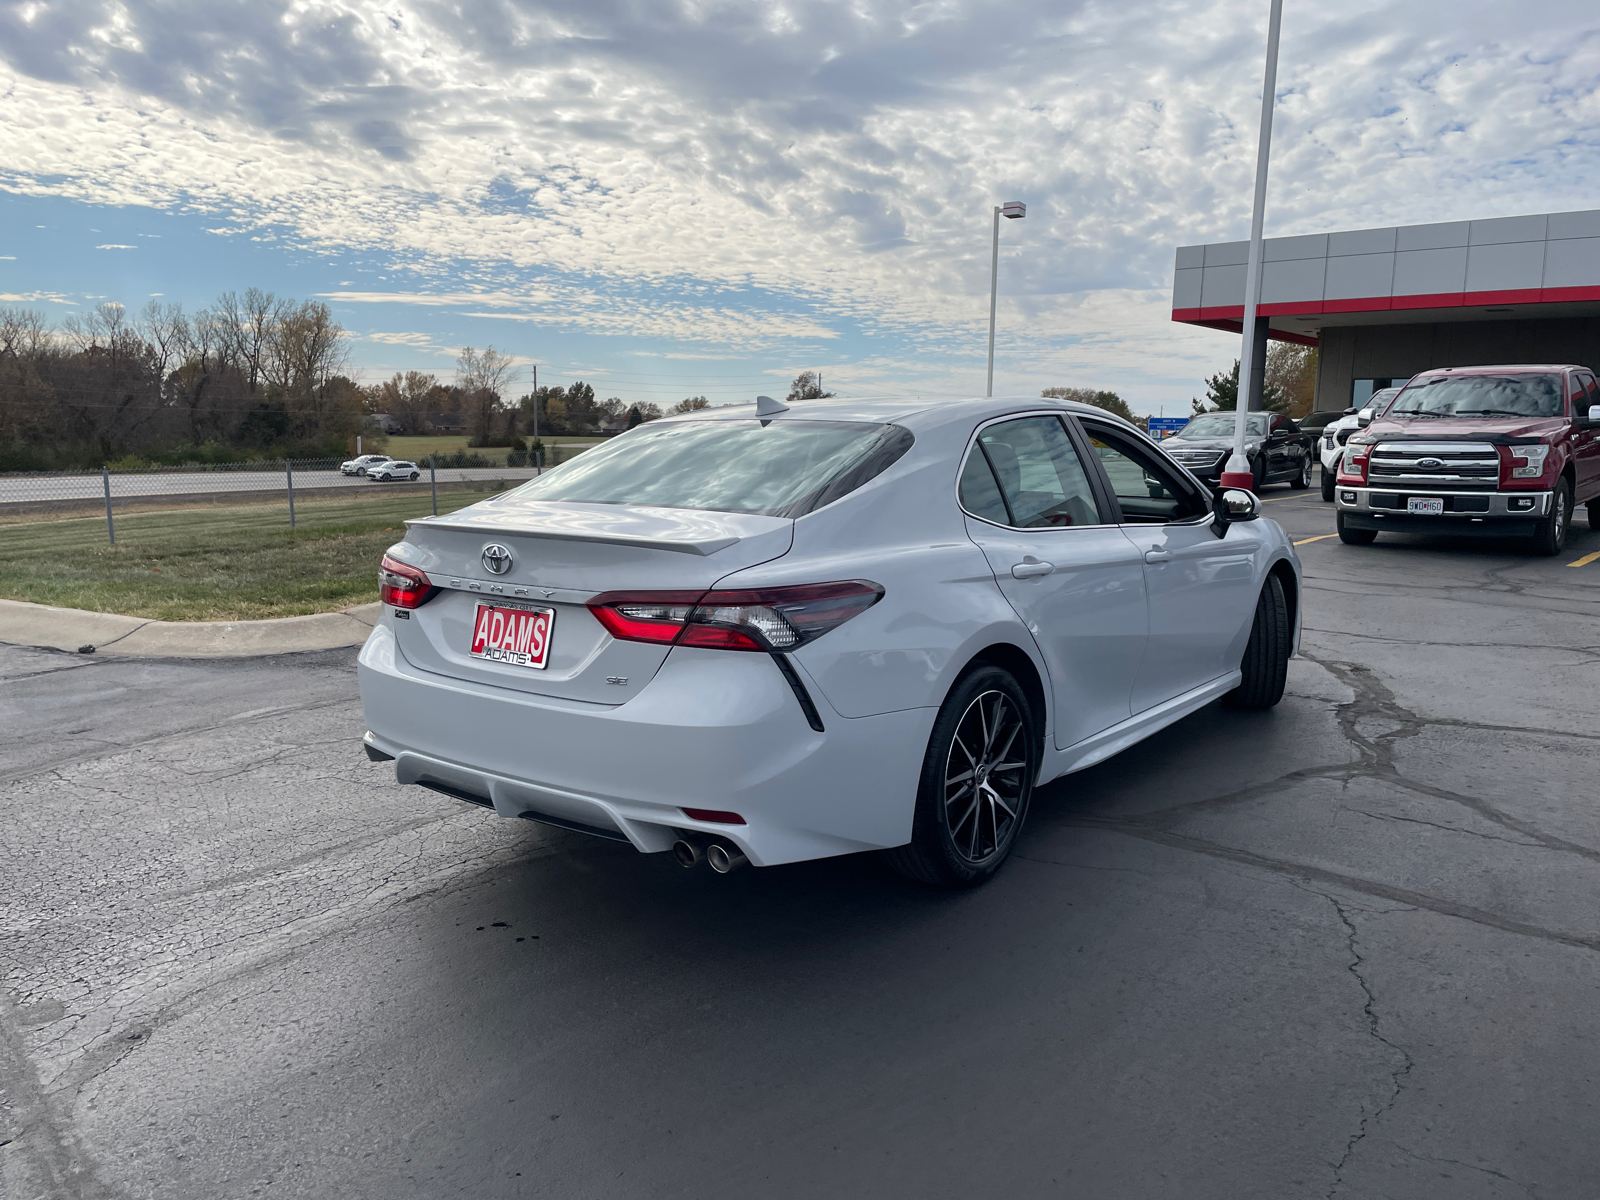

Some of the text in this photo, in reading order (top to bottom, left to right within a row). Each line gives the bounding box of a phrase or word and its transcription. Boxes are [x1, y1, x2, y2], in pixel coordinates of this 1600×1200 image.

[450, 579, 556, 598] CAMRY
[519, 604, 534, 612] CITY
[475, 610, 546, 658] ADAMS
[485, 648, 528, 665] ADAMS
[606, 675, 629, 686] SE
